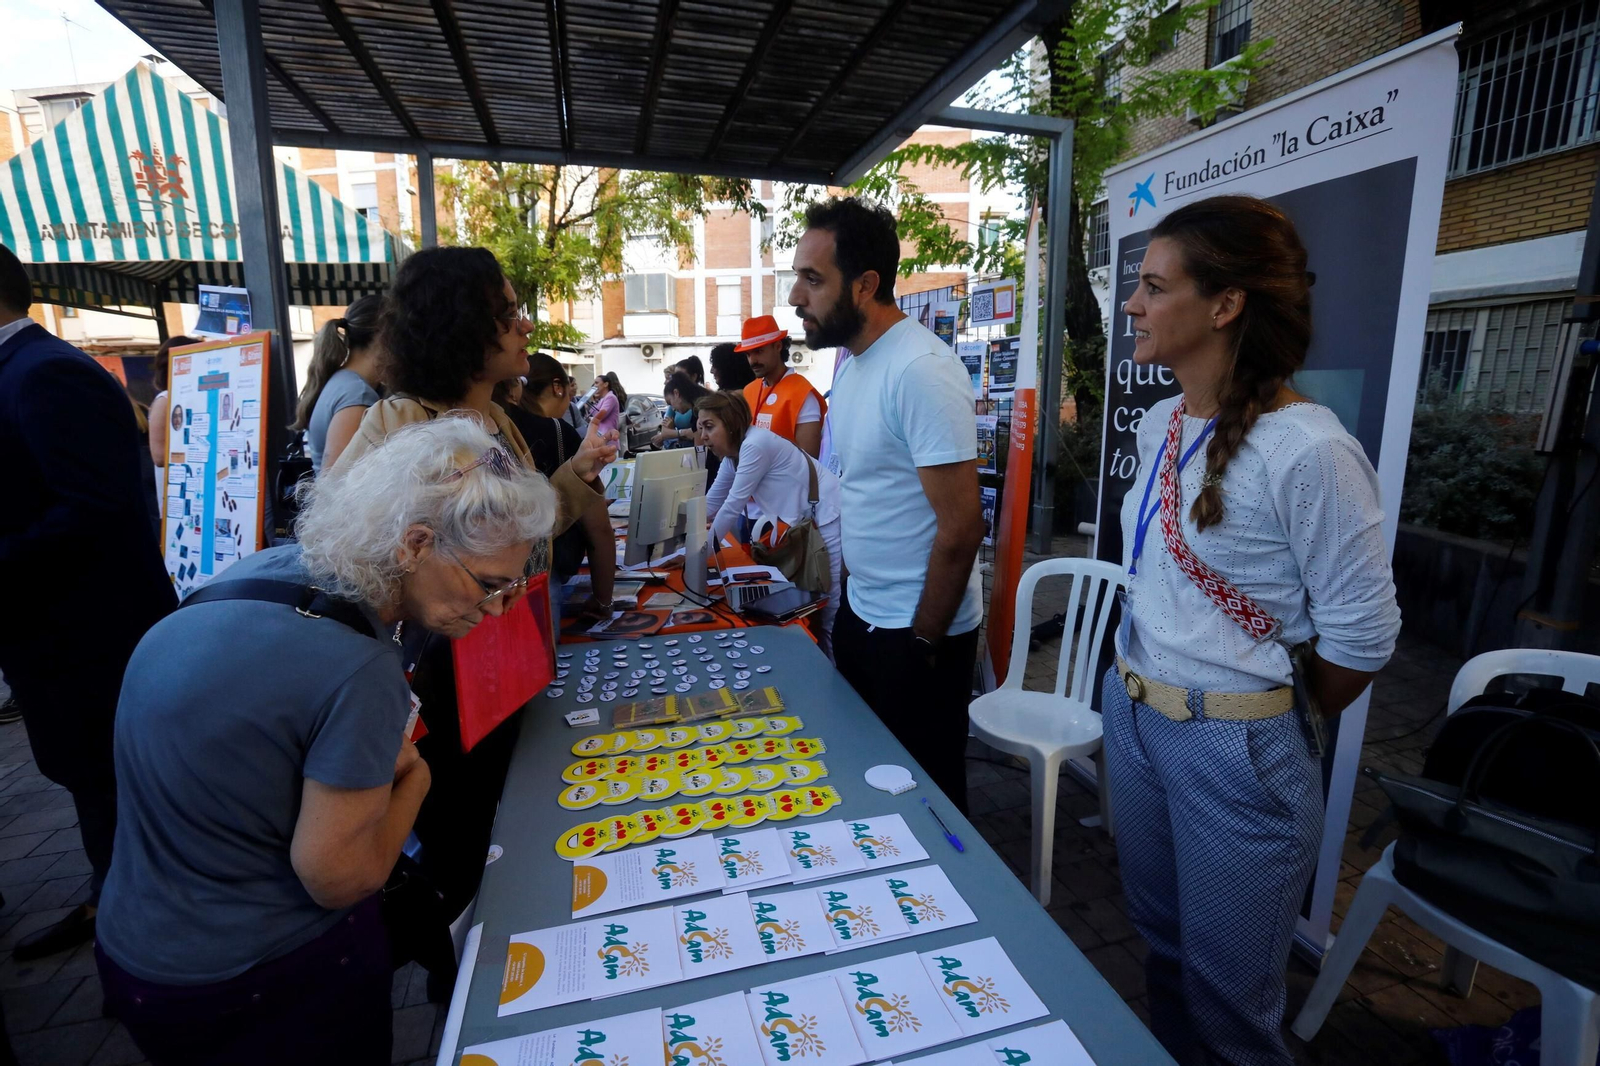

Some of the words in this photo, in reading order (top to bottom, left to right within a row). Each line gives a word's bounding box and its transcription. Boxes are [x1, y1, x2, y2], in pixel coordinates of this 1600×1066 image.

[1164, 146, 1265, 194] Fundación
[41, 220, 174, 241] AYUNTAMIENTO
[178, 221, 202, 238] DE
[1116, 358, 1175, 394] que
